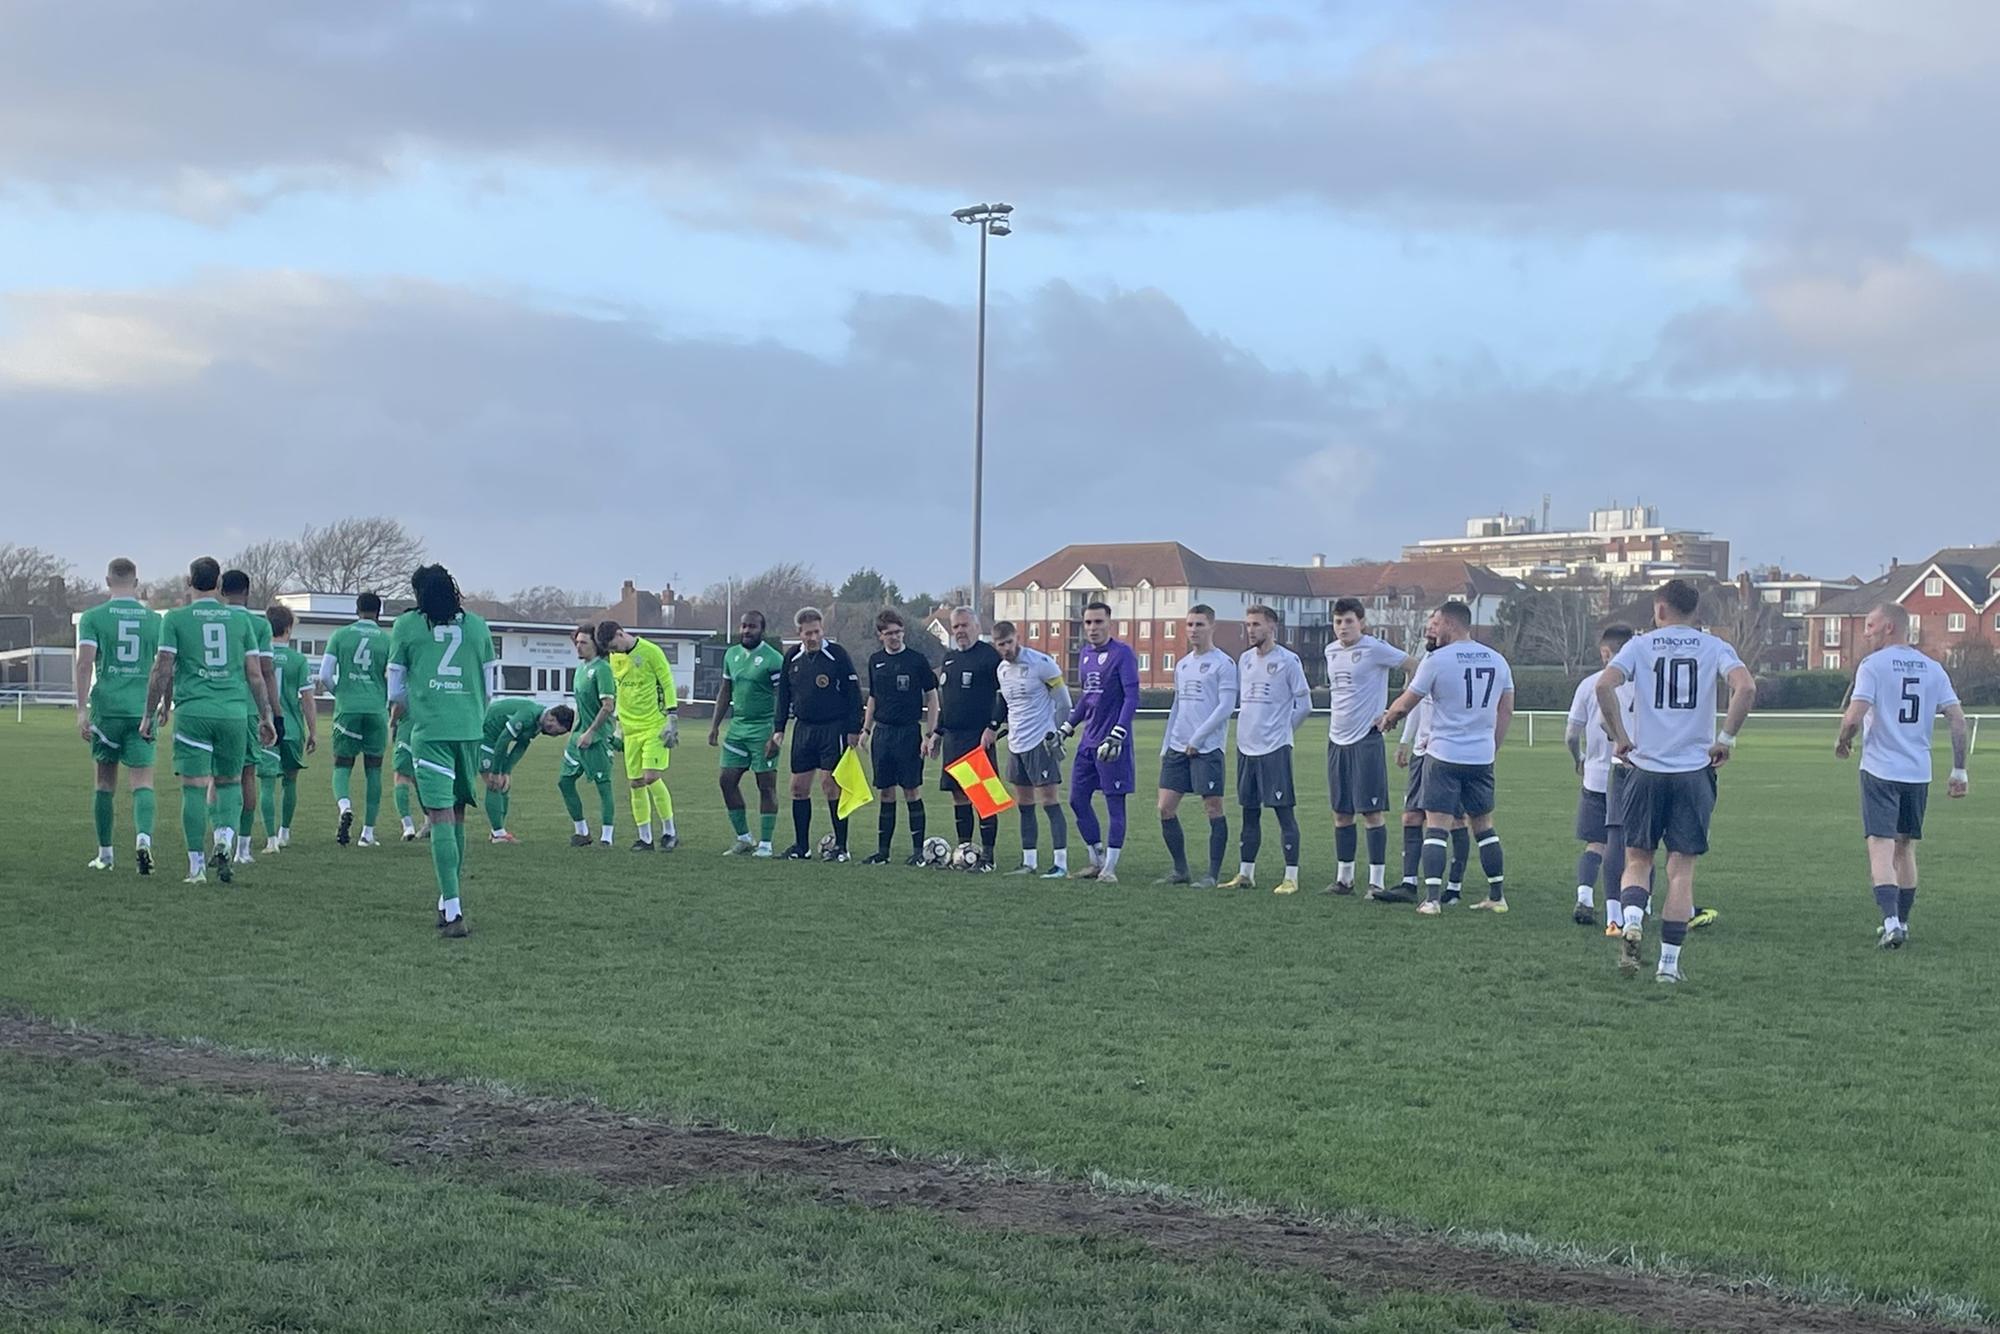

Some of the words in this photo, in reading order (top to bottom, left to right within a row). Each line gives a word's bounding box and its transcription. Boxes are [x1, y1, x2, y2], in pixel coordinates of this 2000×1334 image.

[117, 620, 140, 662] 5
[202, 623, 227, 667] 9
[353, 637, 372, 671] 4
[434, 624, 462, 677] 2
[1653, 637, 1700, 646] macron
[1464, 667, 1496, 709] 17
[1653, 656, 1697, 709] 10
[1899, 677, 1920, 724] 5
